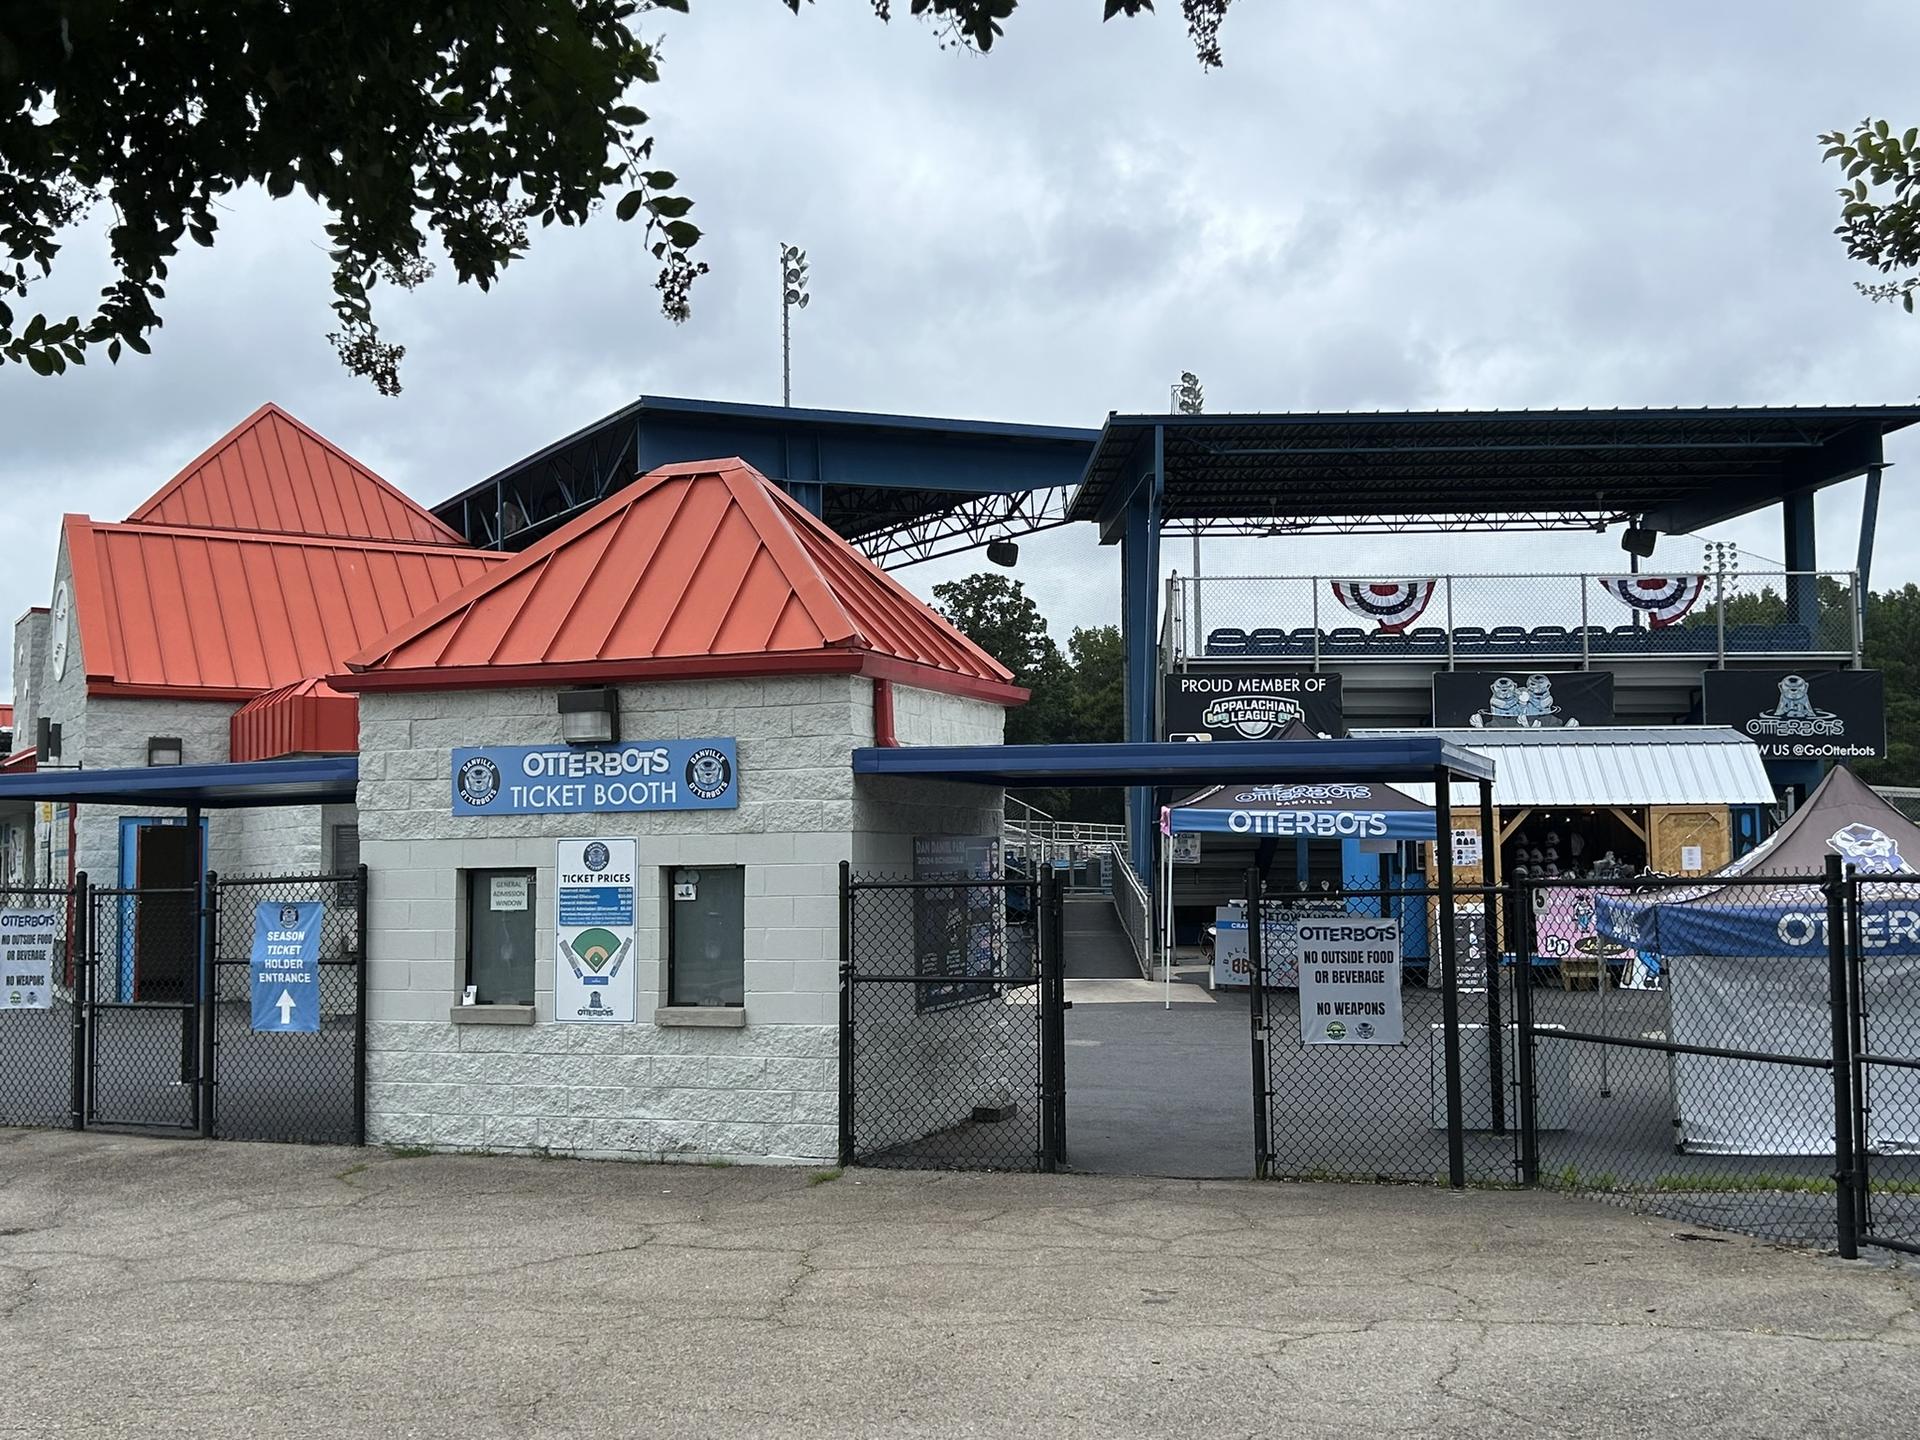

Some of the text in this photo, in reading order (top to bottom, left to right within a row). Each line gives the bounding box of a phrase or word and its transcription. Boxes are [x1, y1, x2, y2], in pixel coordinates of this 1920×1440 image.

[1181, 678, 1327, 693] PROUD MEMBER OF
[1212, 700, 1295, 714] APPALACHIAN
[1231, 711, 1276, 721] LEAGUE
[1746, 719, 1844, 736] OTTERBOTS
[690, 750, 725, 764] DANVILLE
[1772, 744, 1789, 756] US
[1792, 744, 1876, 756] @GoOtterbots
[462, 758, 496, 772] DANVILLE
[522, 748, 670, 778] OTTERBOTS
[460, 789, 497, 805] OTTERBOTS
[510, 781, 677, 808] TICKET BOOTH
[688, 782, 728, 798] OTTERBOTS
[1235, 785, 1372, 803] OTTERBOTS
[1228, 811, 1388, 838] OTTERBOTS
[562, 874, 631, 883] TICKET PRICES
[1, 914, 55, 928] OTTERBOTS
[2, 934, 53, 945] NO OUTSIDE FOOD
[267, 931, 305, 941] SEASON
[1300, 926, 1397, 942] OTTERBOTS
[7, 950, 47, 961] OR BEVERAGE
[267, 945, 302, 955] TICKET
[1304, 950, 1394, 964] NO OUTSIDE FOOD
[264, 959, 304, 969] HOLDER
[6, 975, 45, 986] NO WEAPONS
[259, 973, 311, 983] ENTRANCE
[1315, 970, 1385, 984] OR BEVERAGE
[577, 1008, 614, 1017] OTTERBOTS
[1317, 1002, 1386, 1016] NO WEAPONS
